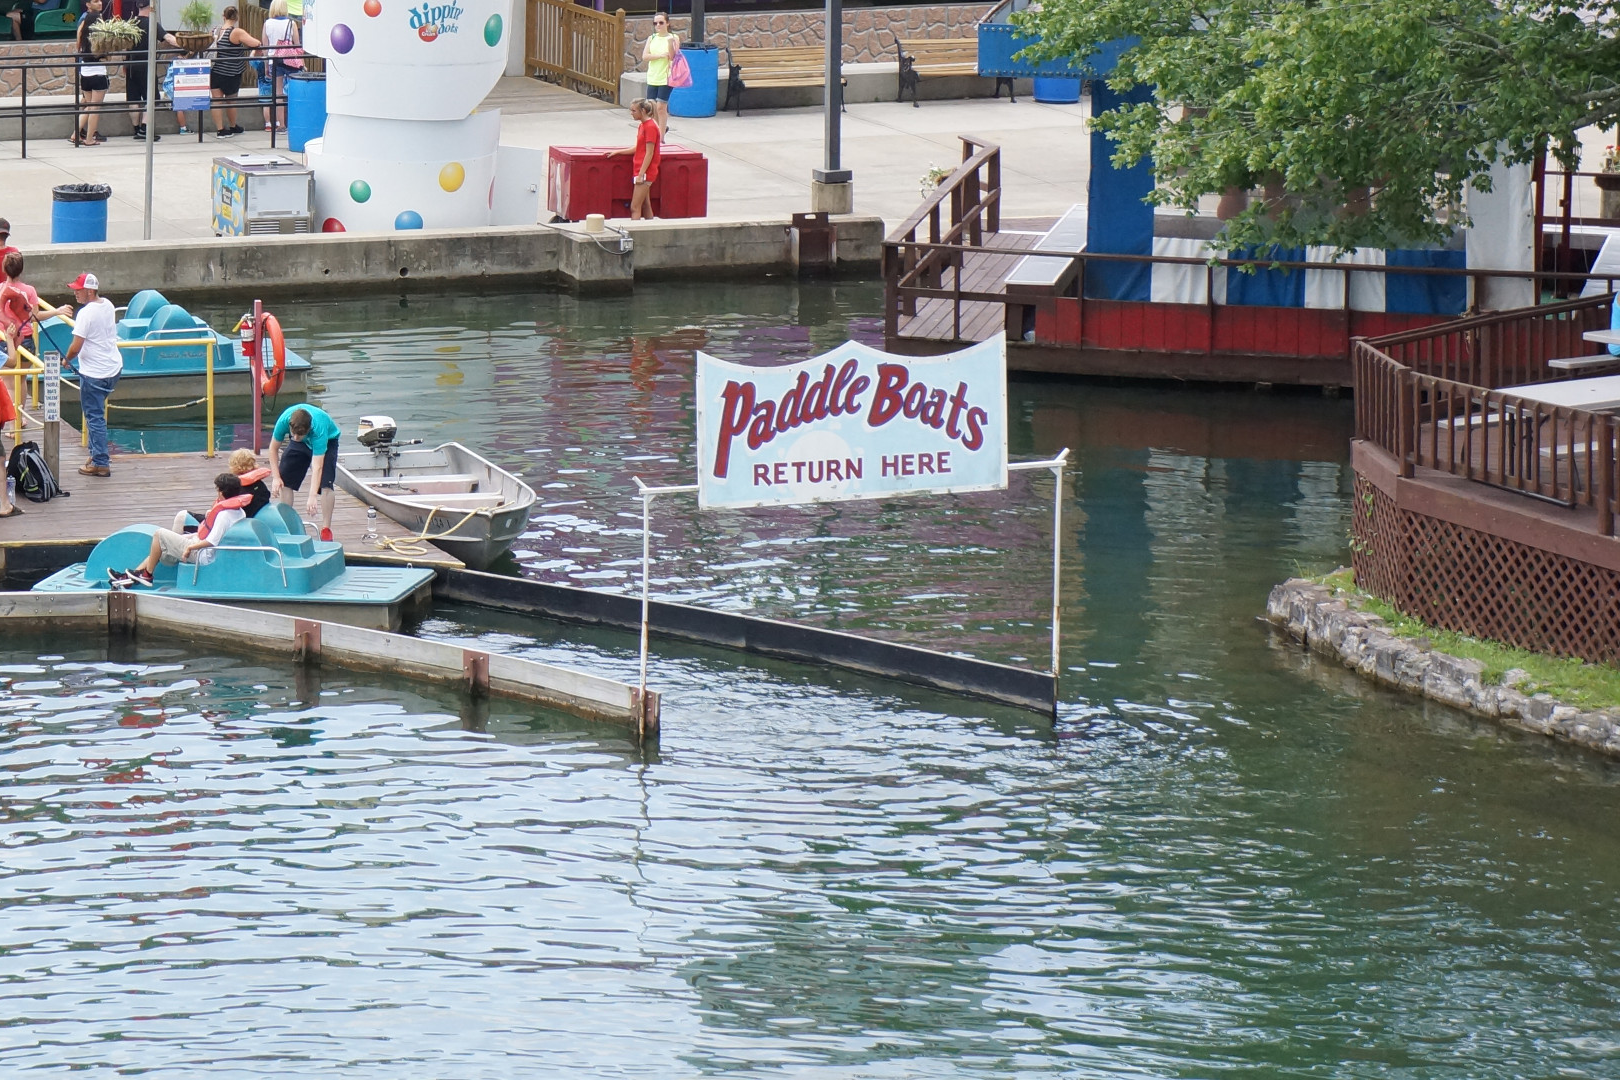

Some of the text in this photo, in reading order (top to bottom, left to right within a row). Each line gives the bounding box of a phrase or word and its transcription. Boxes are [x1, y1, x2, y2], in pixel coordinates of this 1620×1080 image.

[408, 0, 464, 30] dippin'
[438, 23, 459, 35] dots
[713, 358, 988, 480] Paddle Boats
[753, 451, 952, 487] RETURN HERE
